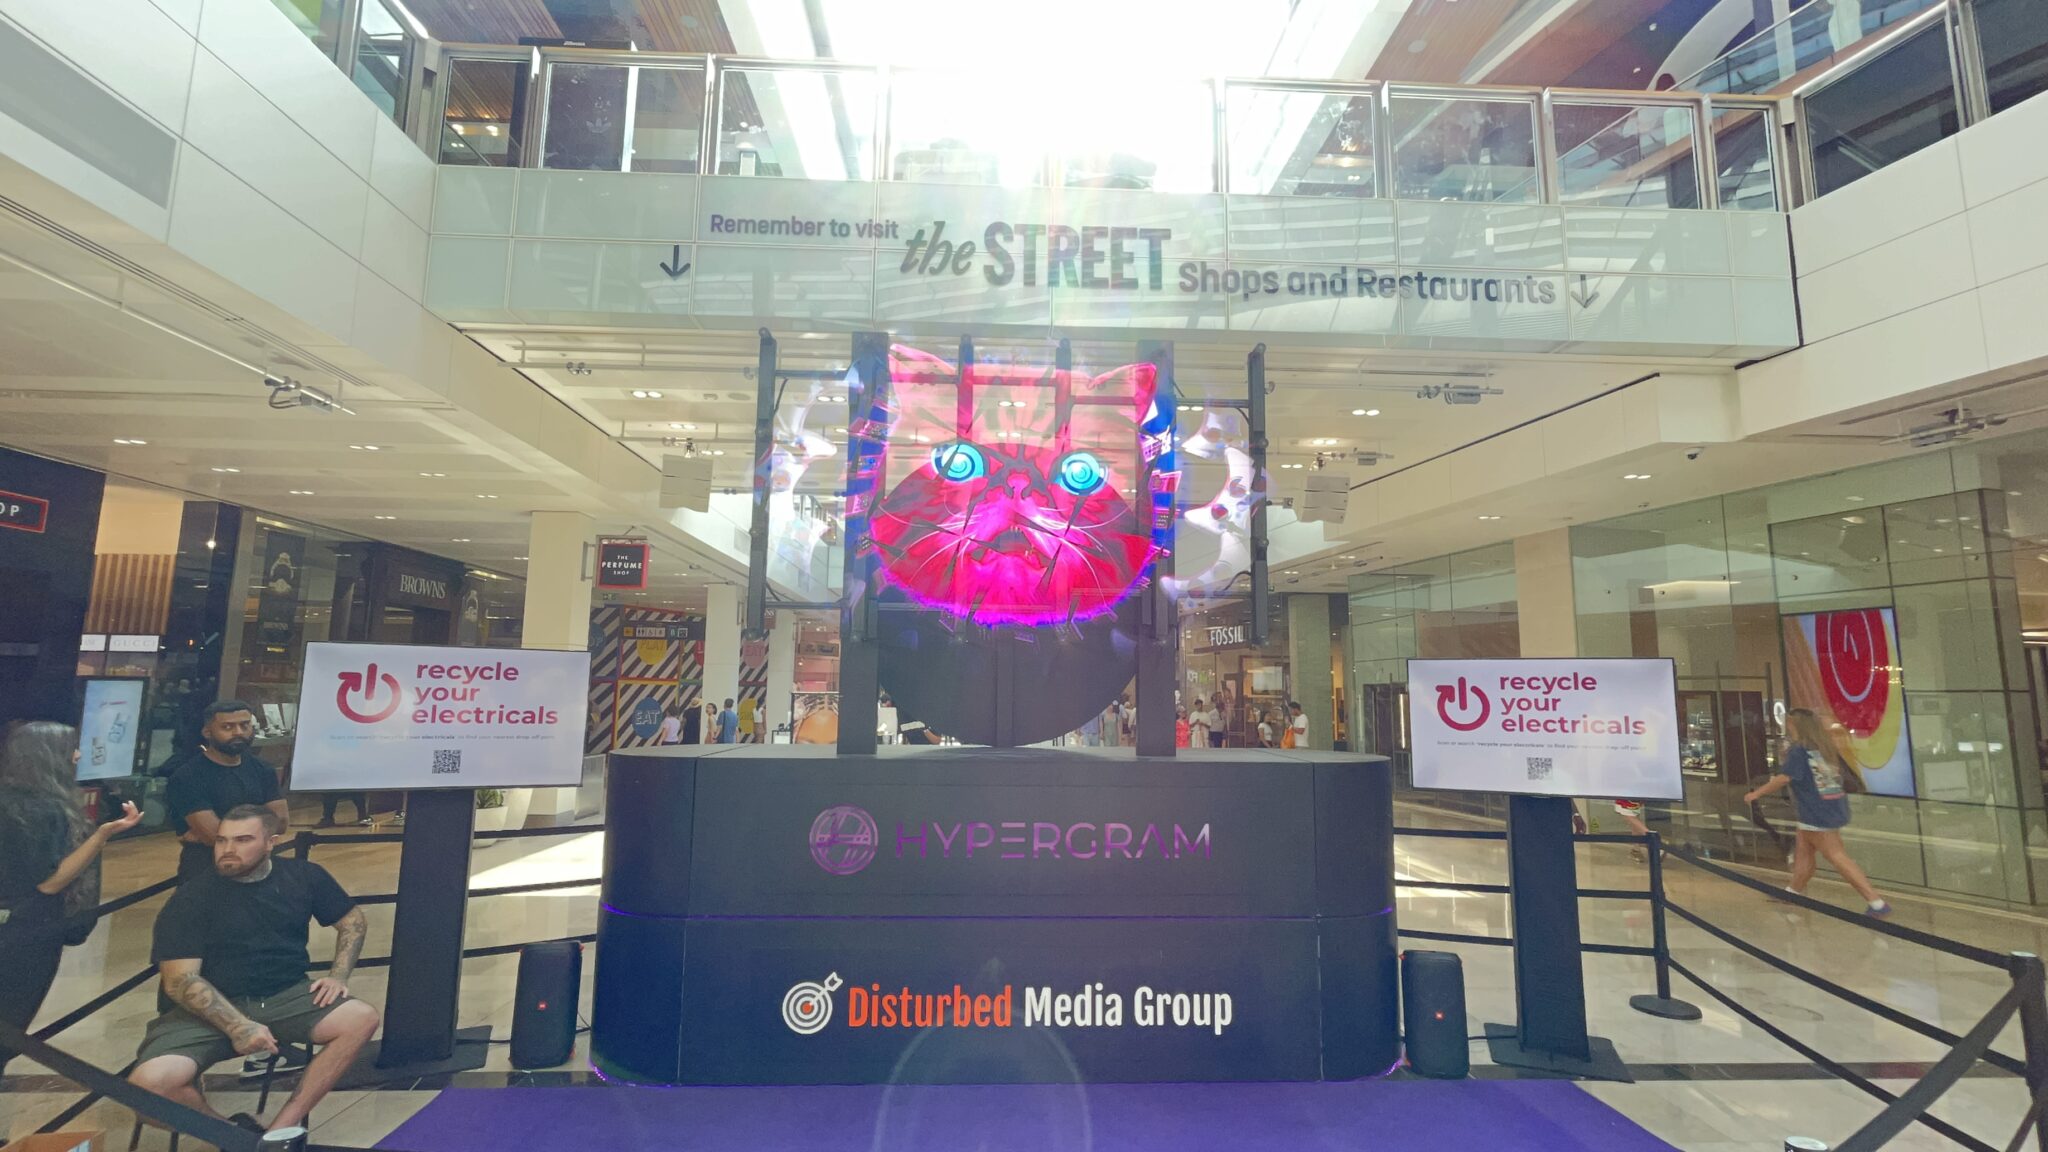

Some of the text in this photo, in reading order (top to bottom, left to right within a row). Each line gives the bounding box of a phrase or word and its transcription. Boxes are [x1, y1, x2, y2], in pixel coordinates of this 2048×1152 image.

[710, 214, 1556, 305] Remember to visit the STREET Shops and Restaurants
[601, 561, 643, 569] PERFUME
[400, 574, 447, 599] BROWNS
[1210, 625, 1244, 647] FOSSIL
[416, 662, 519, 684] recycle
[1500, 672, 1598, 695] recycle
[413, 686, 480, 706] your
[1501, 697, 1561, 716] your
[411, 704, 559, 725] electricals
[635, 711, 660, 725] EAT
[1501, 714, 1648, 735] electricals
[896, 822, 1212, 859] HYPERGRAM
[848, 982, 1233, 1036] Disturbed Media Group
